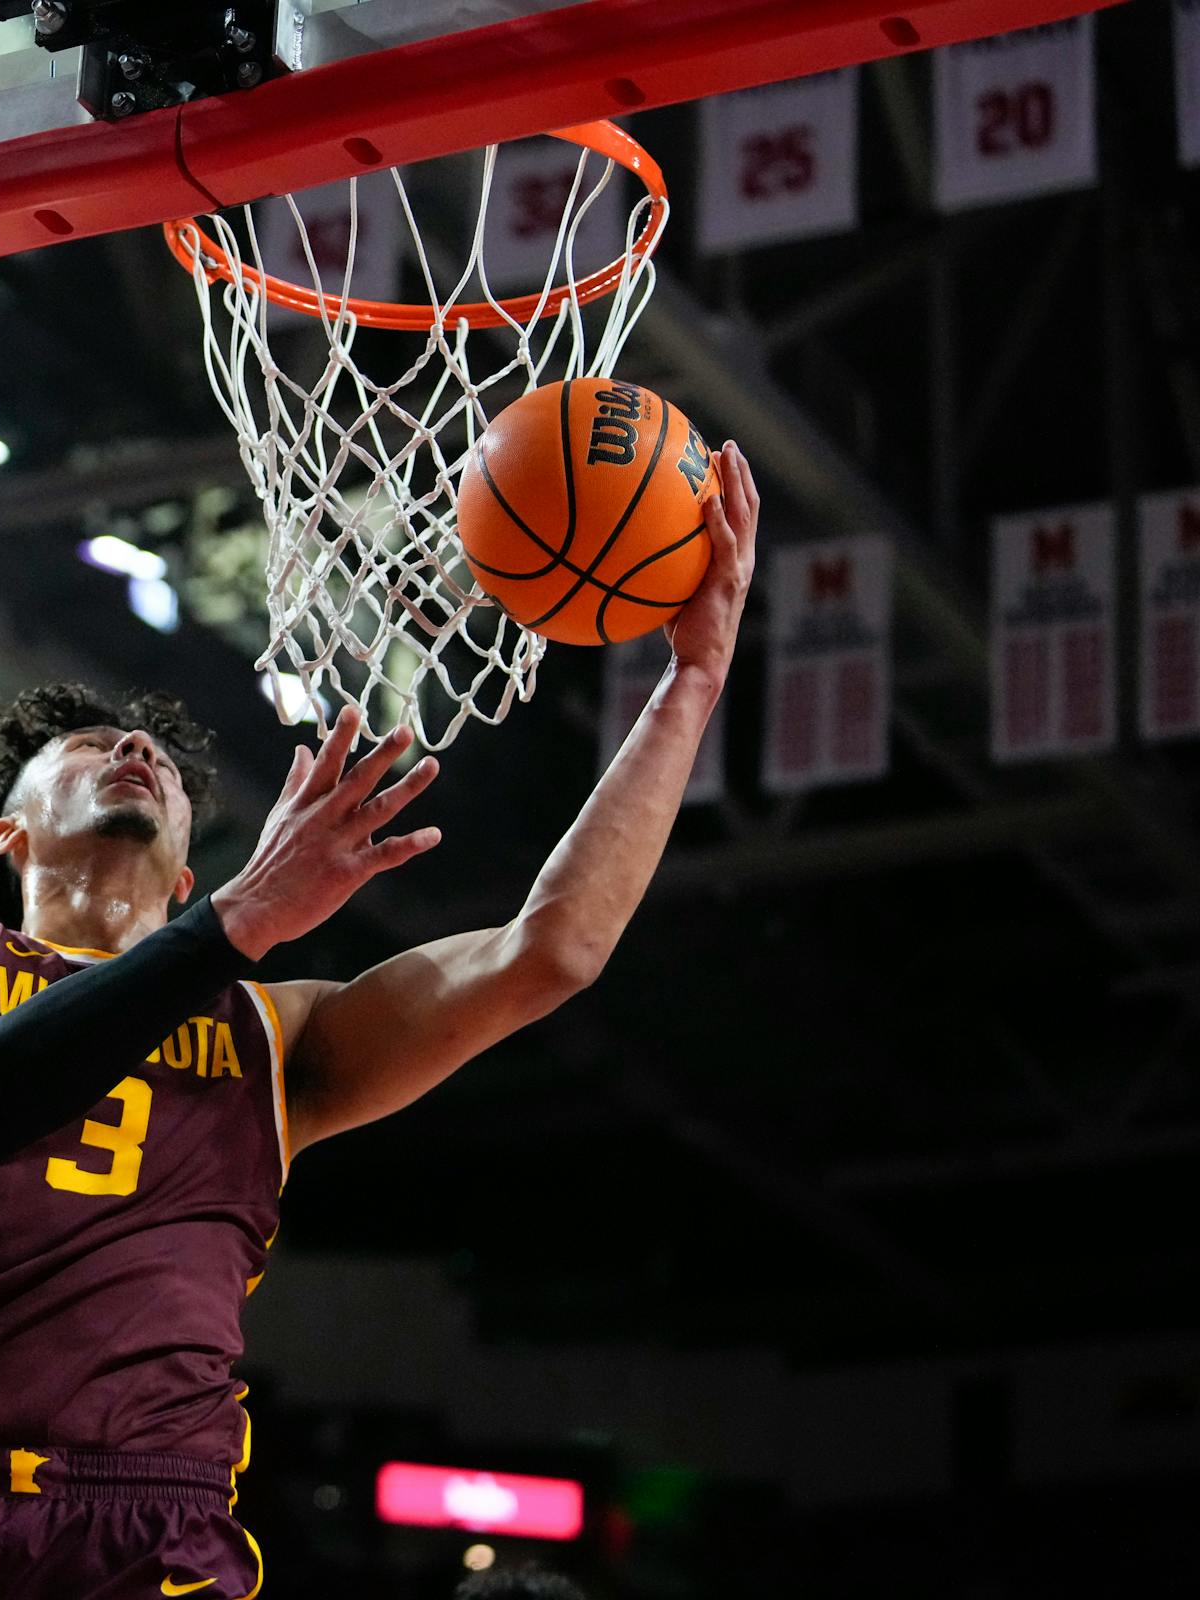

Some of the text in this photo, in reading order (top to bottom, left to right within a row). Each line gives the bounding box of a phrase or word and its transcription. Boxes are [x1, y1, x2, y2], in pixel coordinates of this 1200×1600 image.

[978, 81, 1054, 158] 20
[741, 124, 815, 200] 25
[676, 420, 711, 497] NC
[45, 1076, 153, 1197] 3
